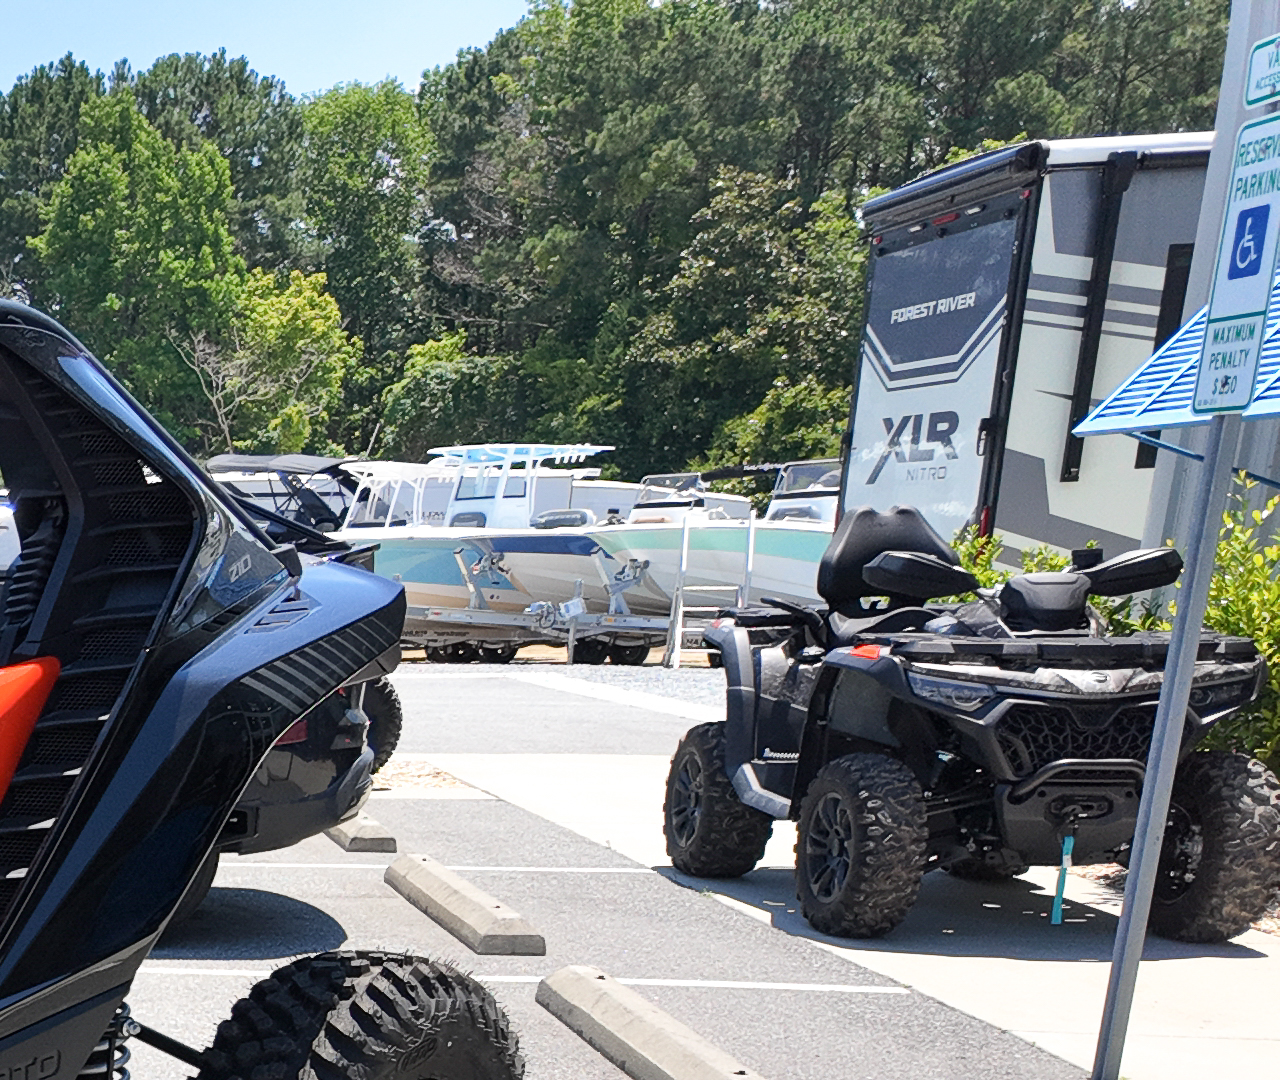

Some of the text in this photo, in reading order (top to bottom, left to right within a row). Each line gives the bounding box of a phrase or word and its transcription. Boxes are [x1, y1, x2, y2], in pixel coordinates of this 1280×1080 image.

[890, 291, 976, 324] FOREST RIVER
[1211, 322, 1256, 346] MAXIMUM
[1208, 348, 1251, 371] PENALTY
[865, 410, 960, 485] XLR
[905, 466, 947, 481] NITRO
